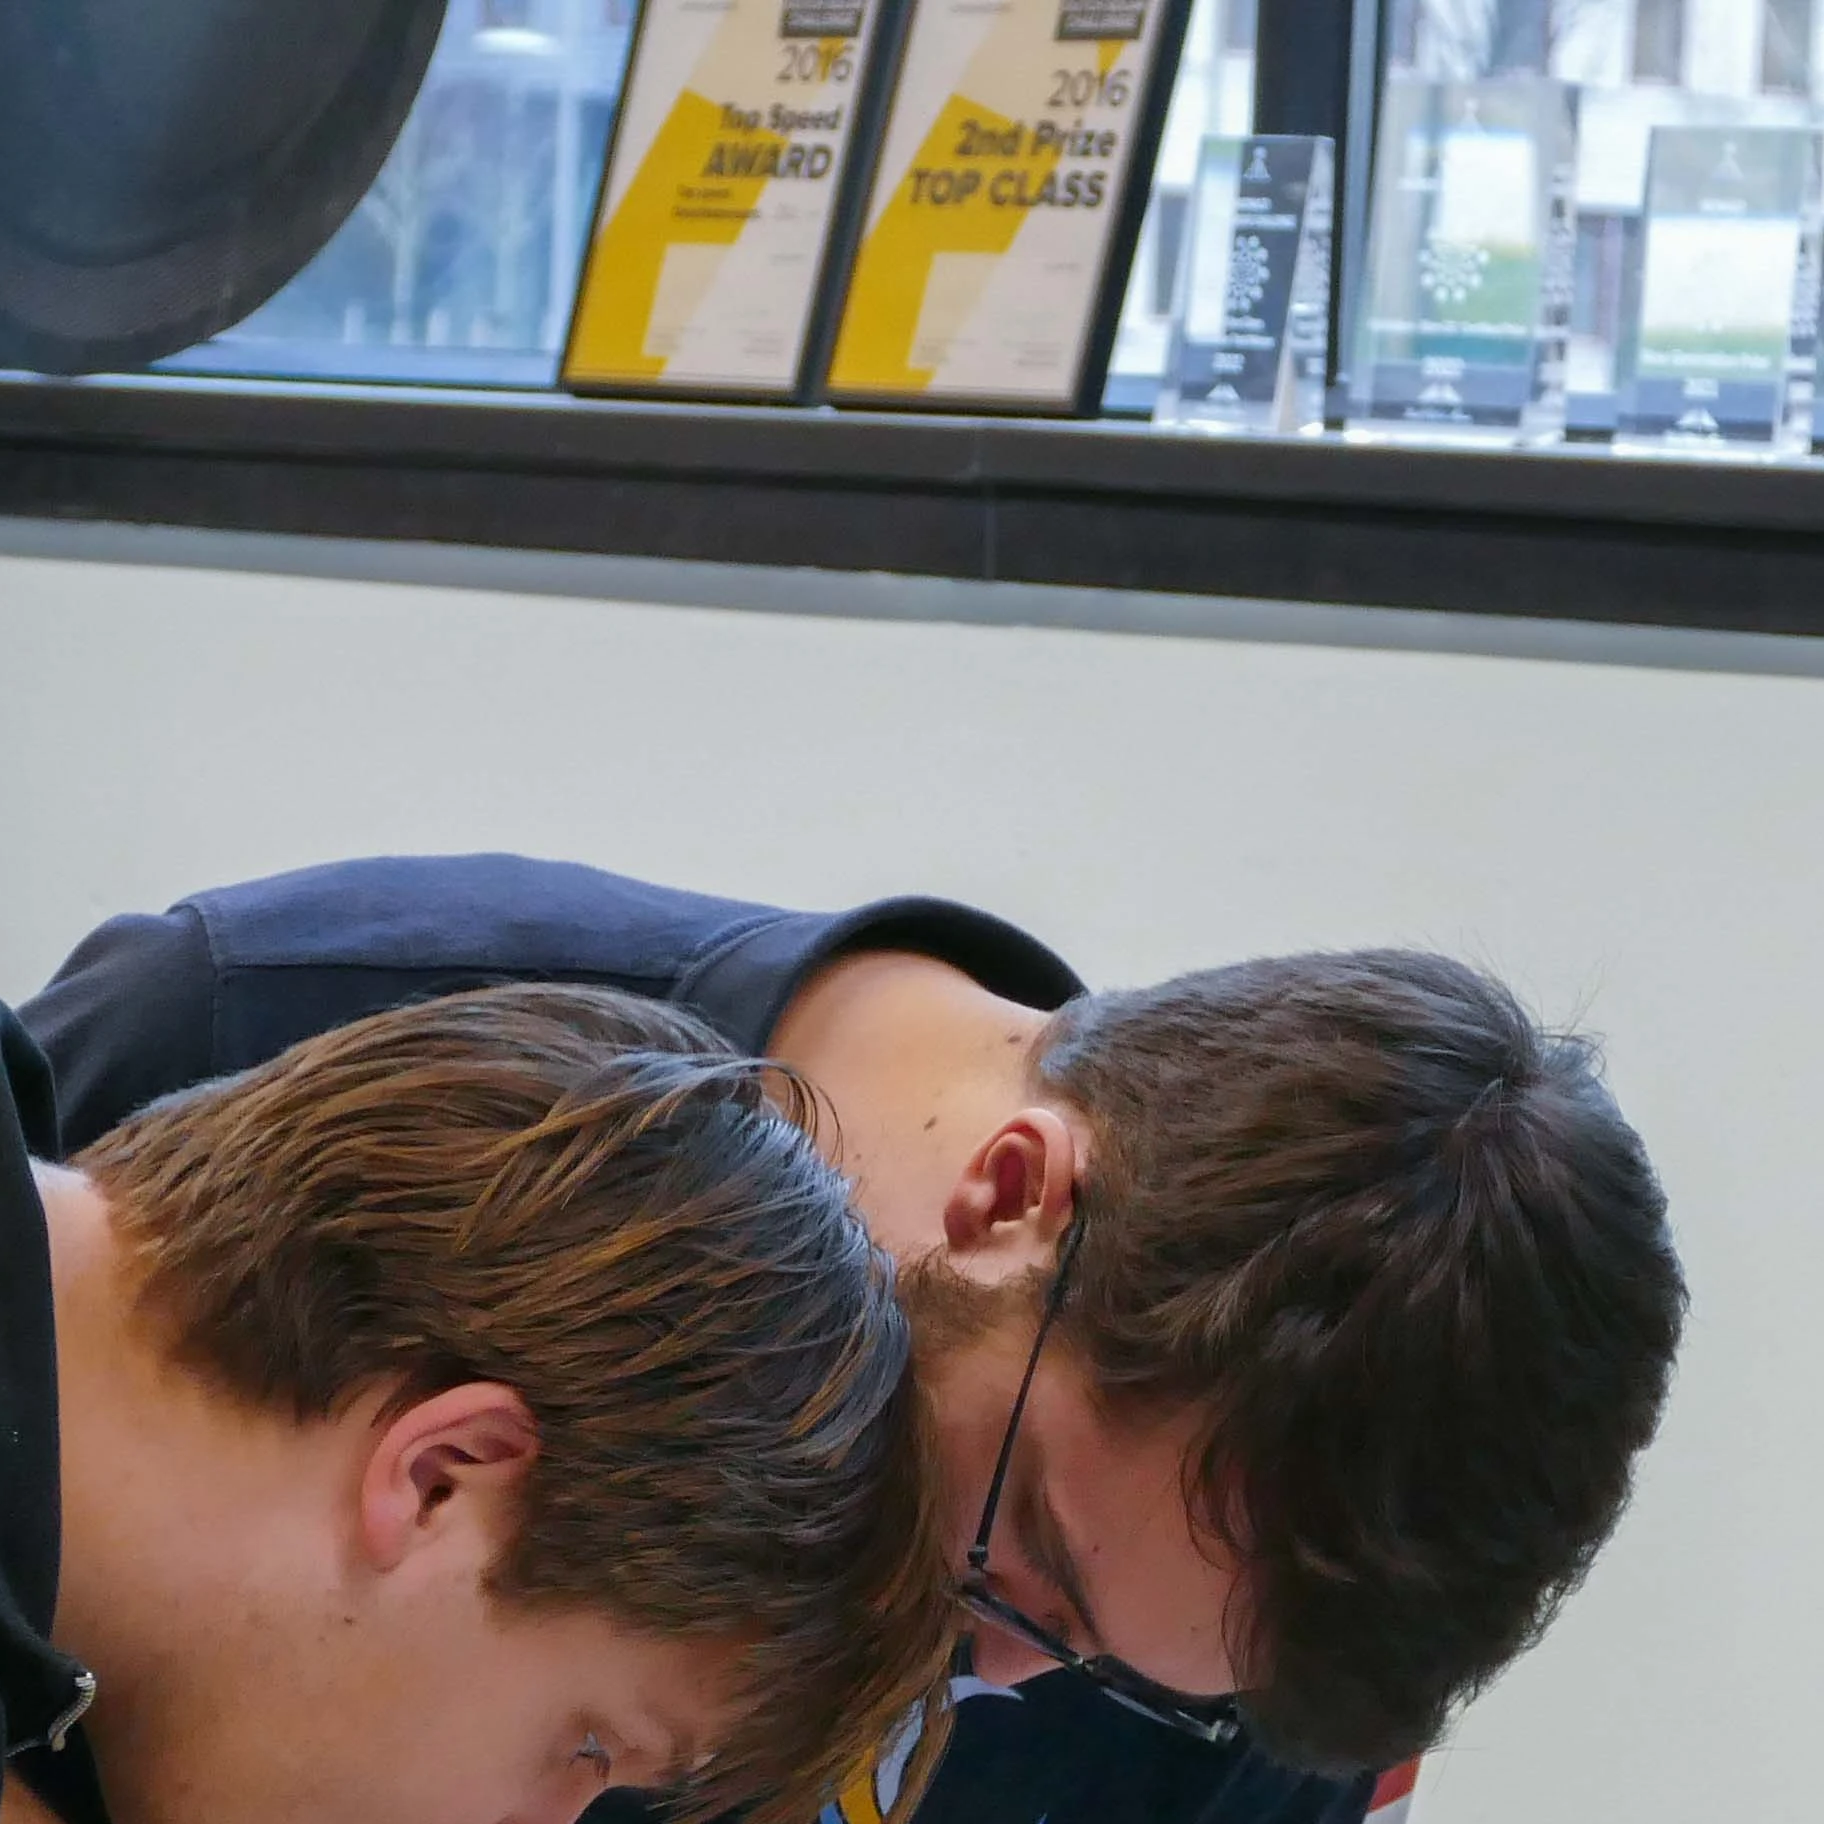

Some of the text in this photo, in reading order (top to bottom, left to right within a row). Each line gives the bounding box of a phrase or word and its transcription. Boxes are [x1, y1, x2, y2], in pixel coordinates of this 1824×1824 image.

[776, 44, 854, 83] 2016
[1046, 68, 1131, 108] 2016
[721, 101, 843, 134] Top Speed
[954, 117, 1117, 158] 2nd Prize
[701, 140, 833, 179] AWARD
[910, 167, 1107, 209] TOP CLASS
